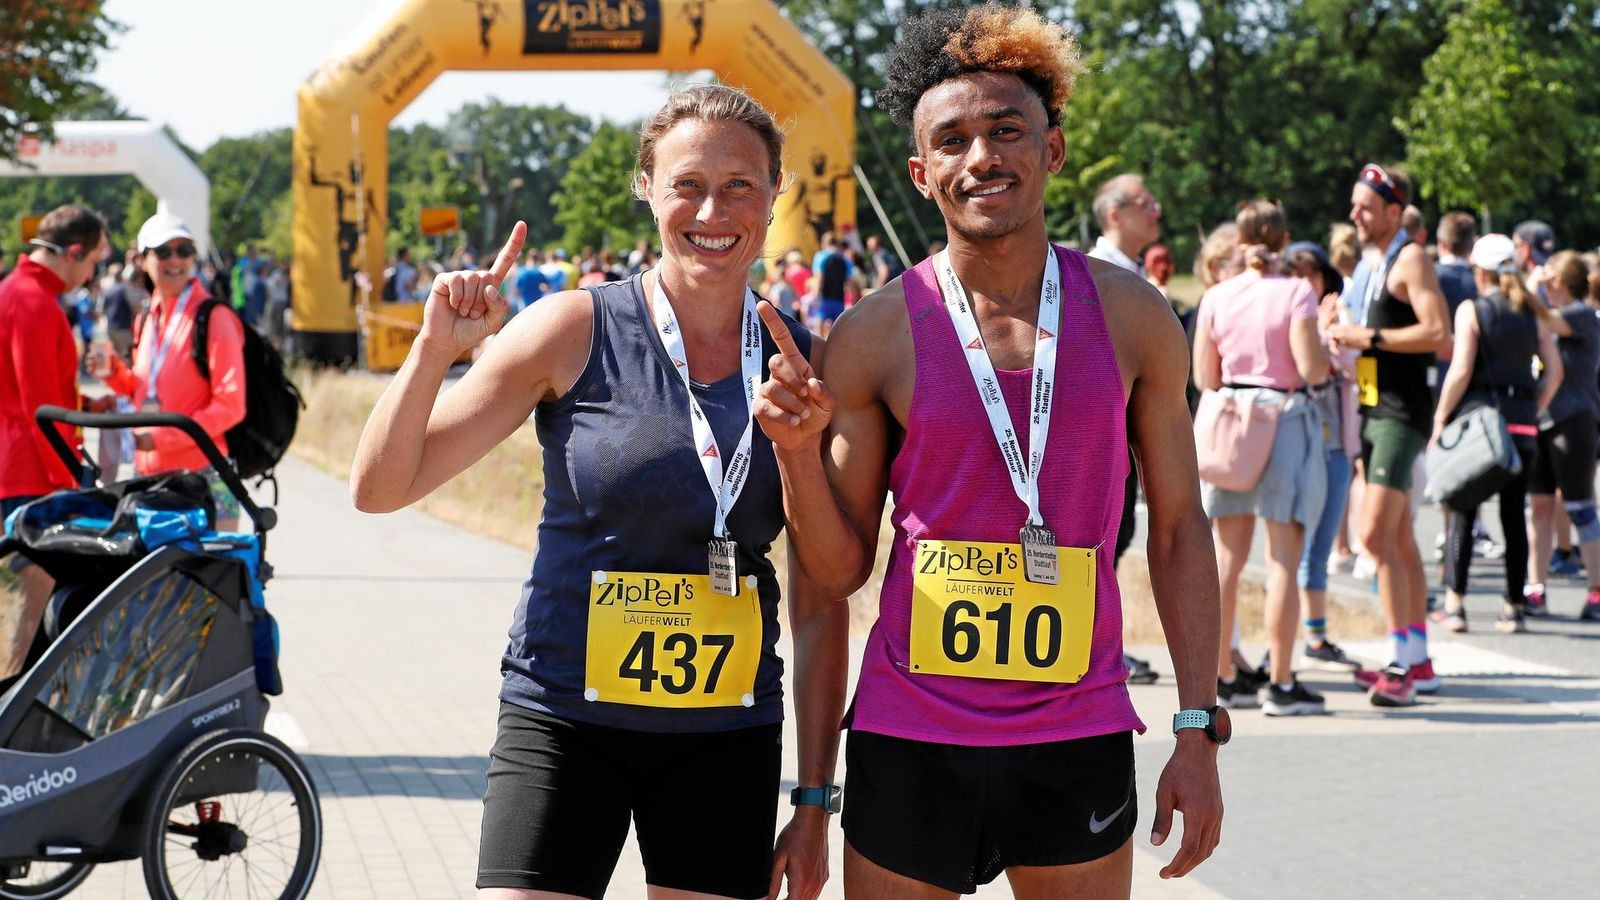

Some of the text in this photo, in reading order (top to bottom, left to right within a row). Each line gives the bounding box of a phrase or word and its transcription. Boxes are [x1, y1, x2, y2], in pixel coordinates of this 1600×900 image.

[745, 309, 753, 347] Norderstedter
[1034, 368, 1043, 413] Norderstedter
[1041, 381, 1050, 414] Stadtlauf
[727, 452, 744, 483] Stadtlauf
[1002, 441, 1017, 473] Stadtlauf
[1005, 428, 1026, 484] 25. Norderstedter
[919, 545, 1018, 576] ZipPel's
[595, 577, 694, 607] ZipPel's
[945, 583, 1014, 597] LÄUFERWELT
[623, 614, 692, 627] LÄUFERWELT
[941, 600, 1062, 668] 610
[618, 631, 735, 695] 437
[0, 766, 77, 808] Qeridoo
